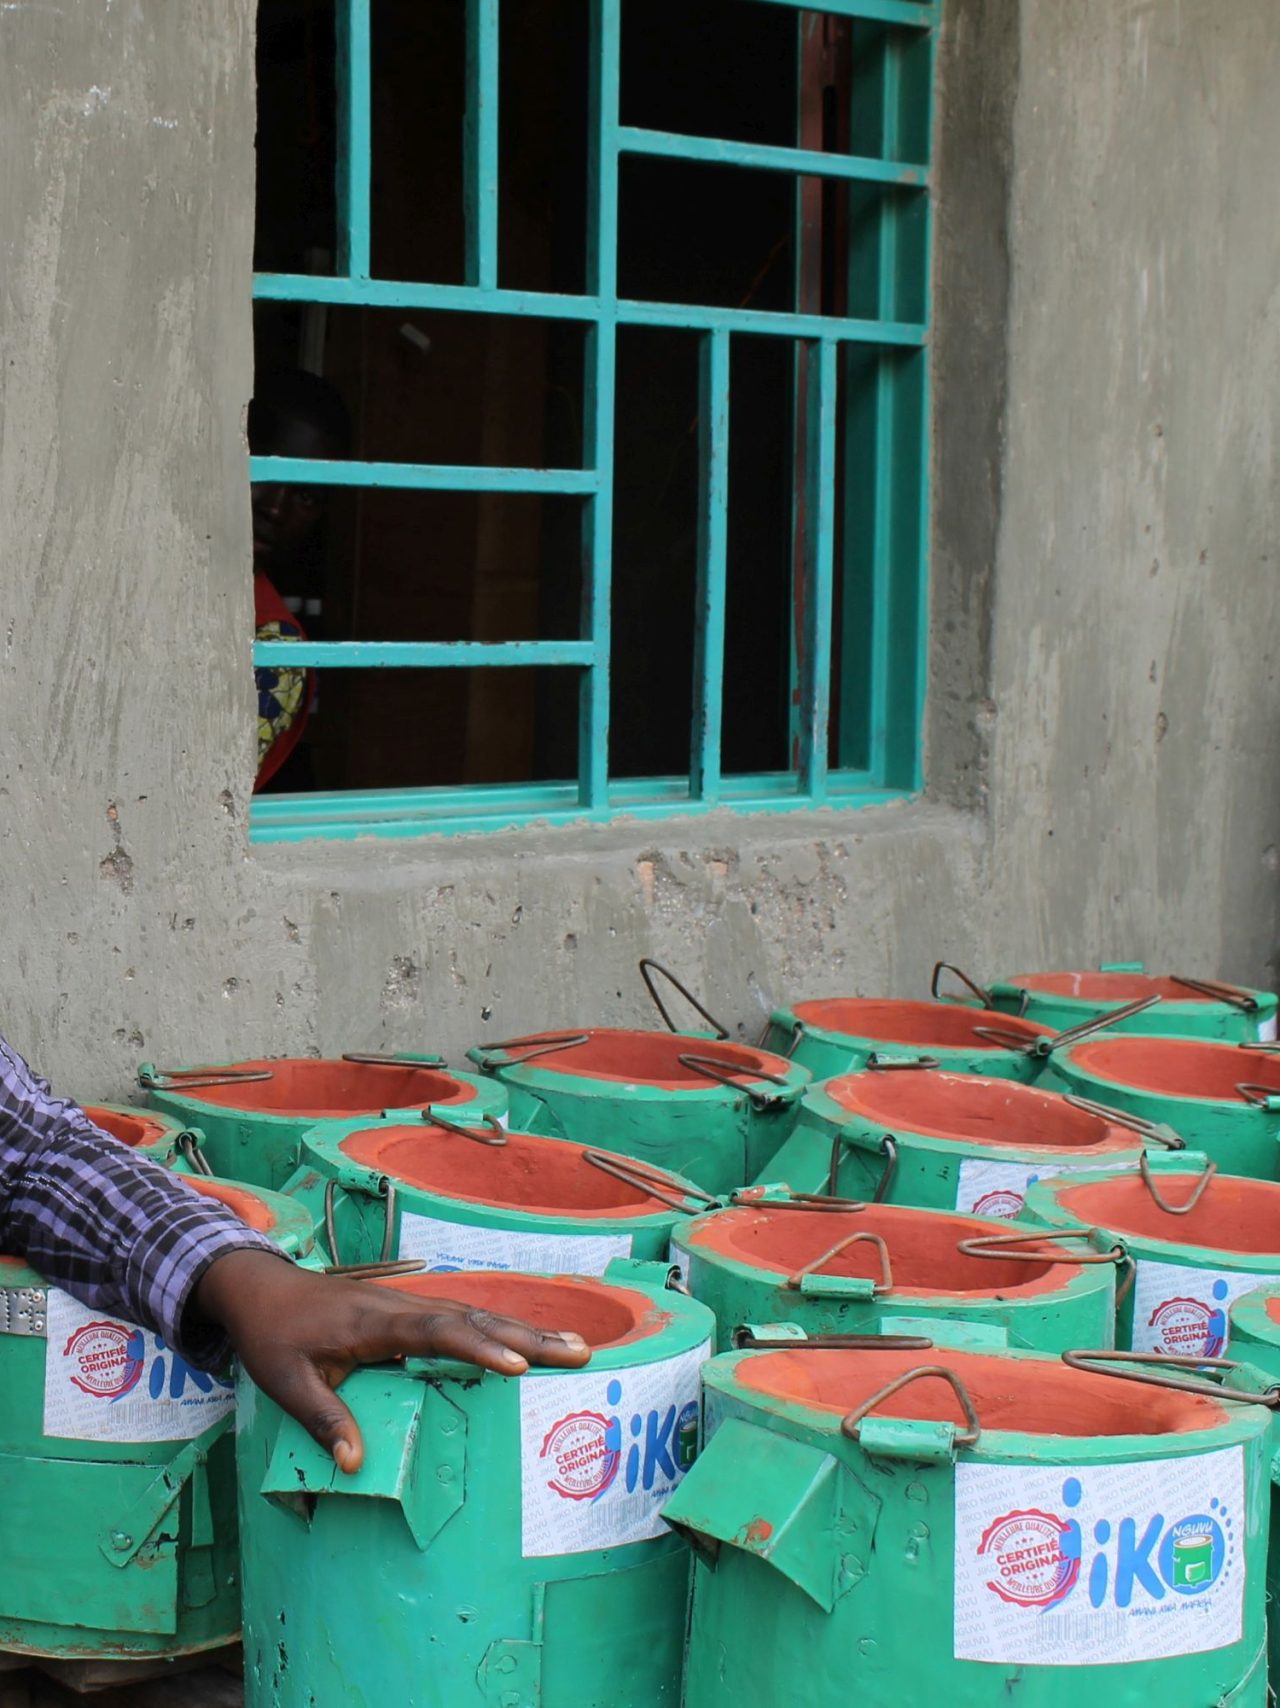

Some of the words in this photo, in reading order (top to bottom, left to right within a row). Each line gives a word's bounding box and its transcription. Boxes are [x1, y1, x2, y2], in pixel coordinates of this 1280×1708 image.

[1161, 1321, 1208, 1336] CERTIFIÉ
[1164, 1331, 1214, 1344] ORIGINAL
[78, 1345, 128, 1364] CERTIFIÉ
[81, 1355, 134, 1374] ORIGINAL
[555, 1435, 606, 1465] CERTIFIÉ
[558, 1447, 612, 1475] ORIGINAL
[1171, 1520, 1214, 1538] NGUVU
[996, 1538, 1060, 1566] CERTIFIÉ
[1000, 1551, 1069, 1577] ORIGINAL
